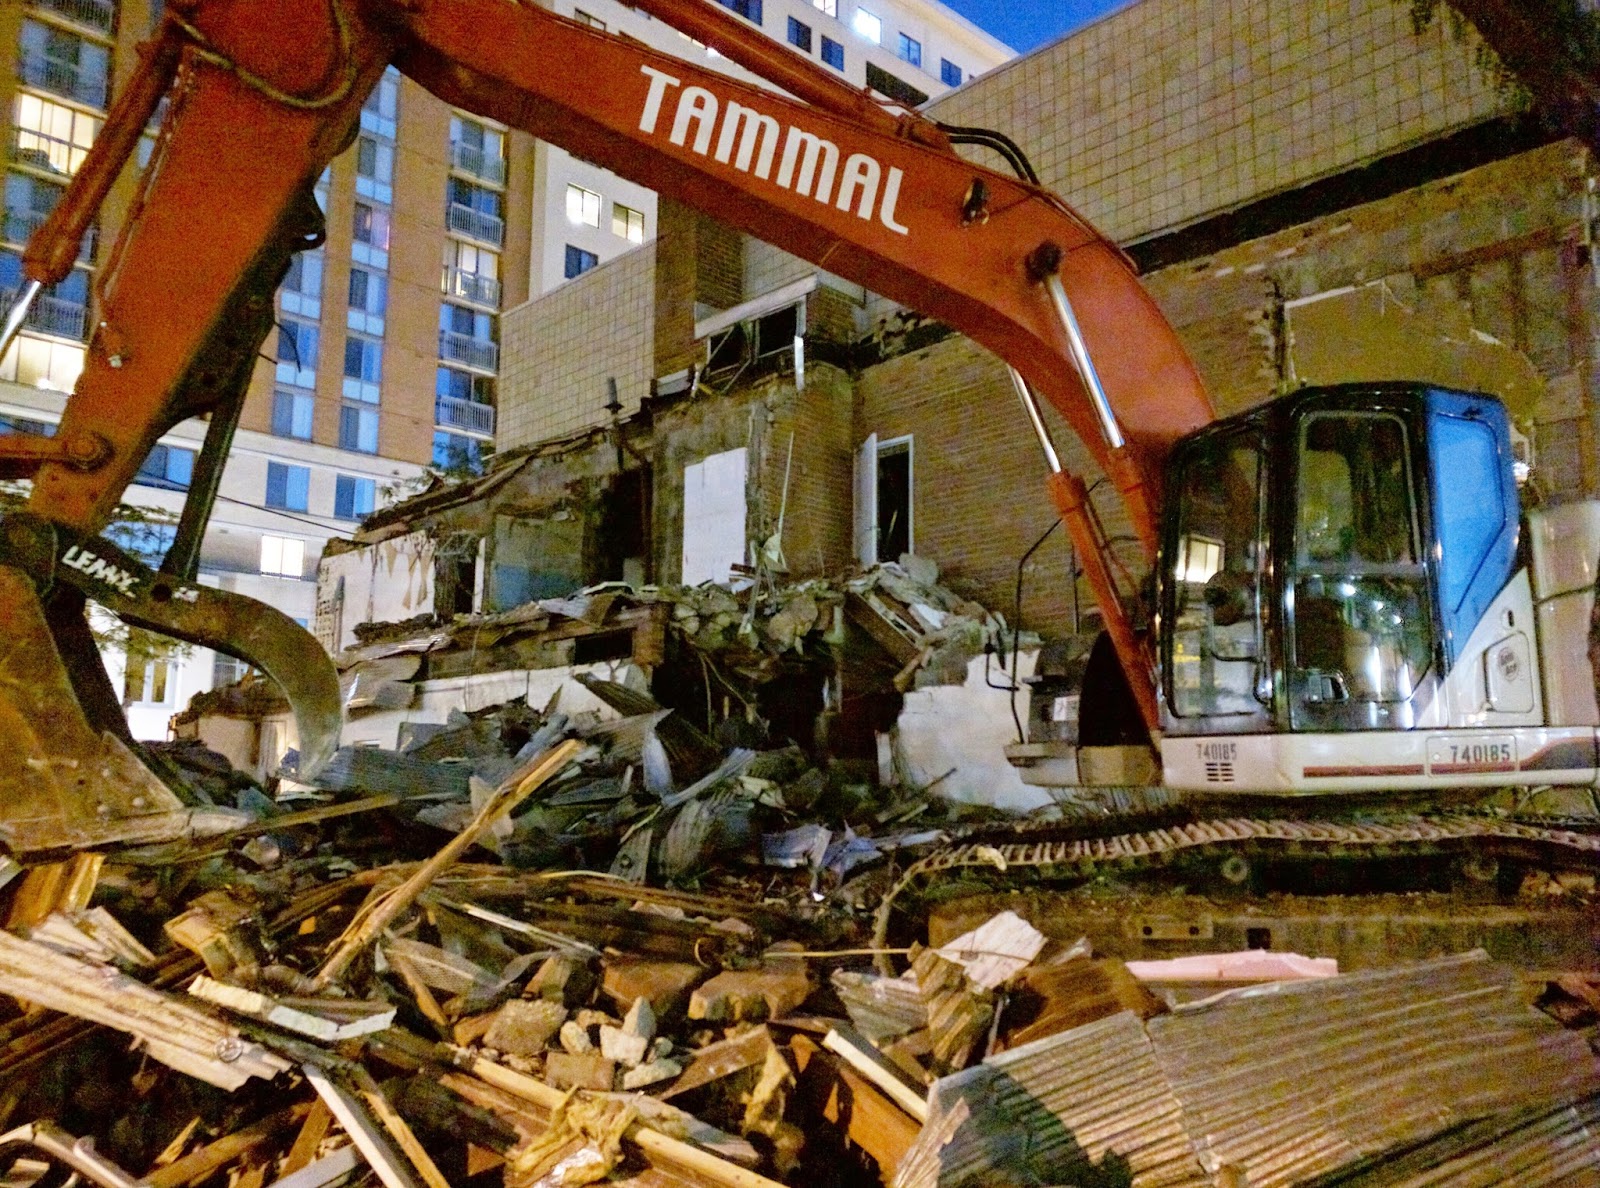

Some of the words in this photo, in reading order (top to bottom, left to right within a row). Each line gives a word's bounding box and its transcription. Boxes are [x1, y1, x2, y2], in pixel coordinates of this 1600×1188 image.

[639, 65, 909, 236] TAMMAL
[1196, 743, 1238, 760] 740185
[1449, 743, 1511, 763] 740185
